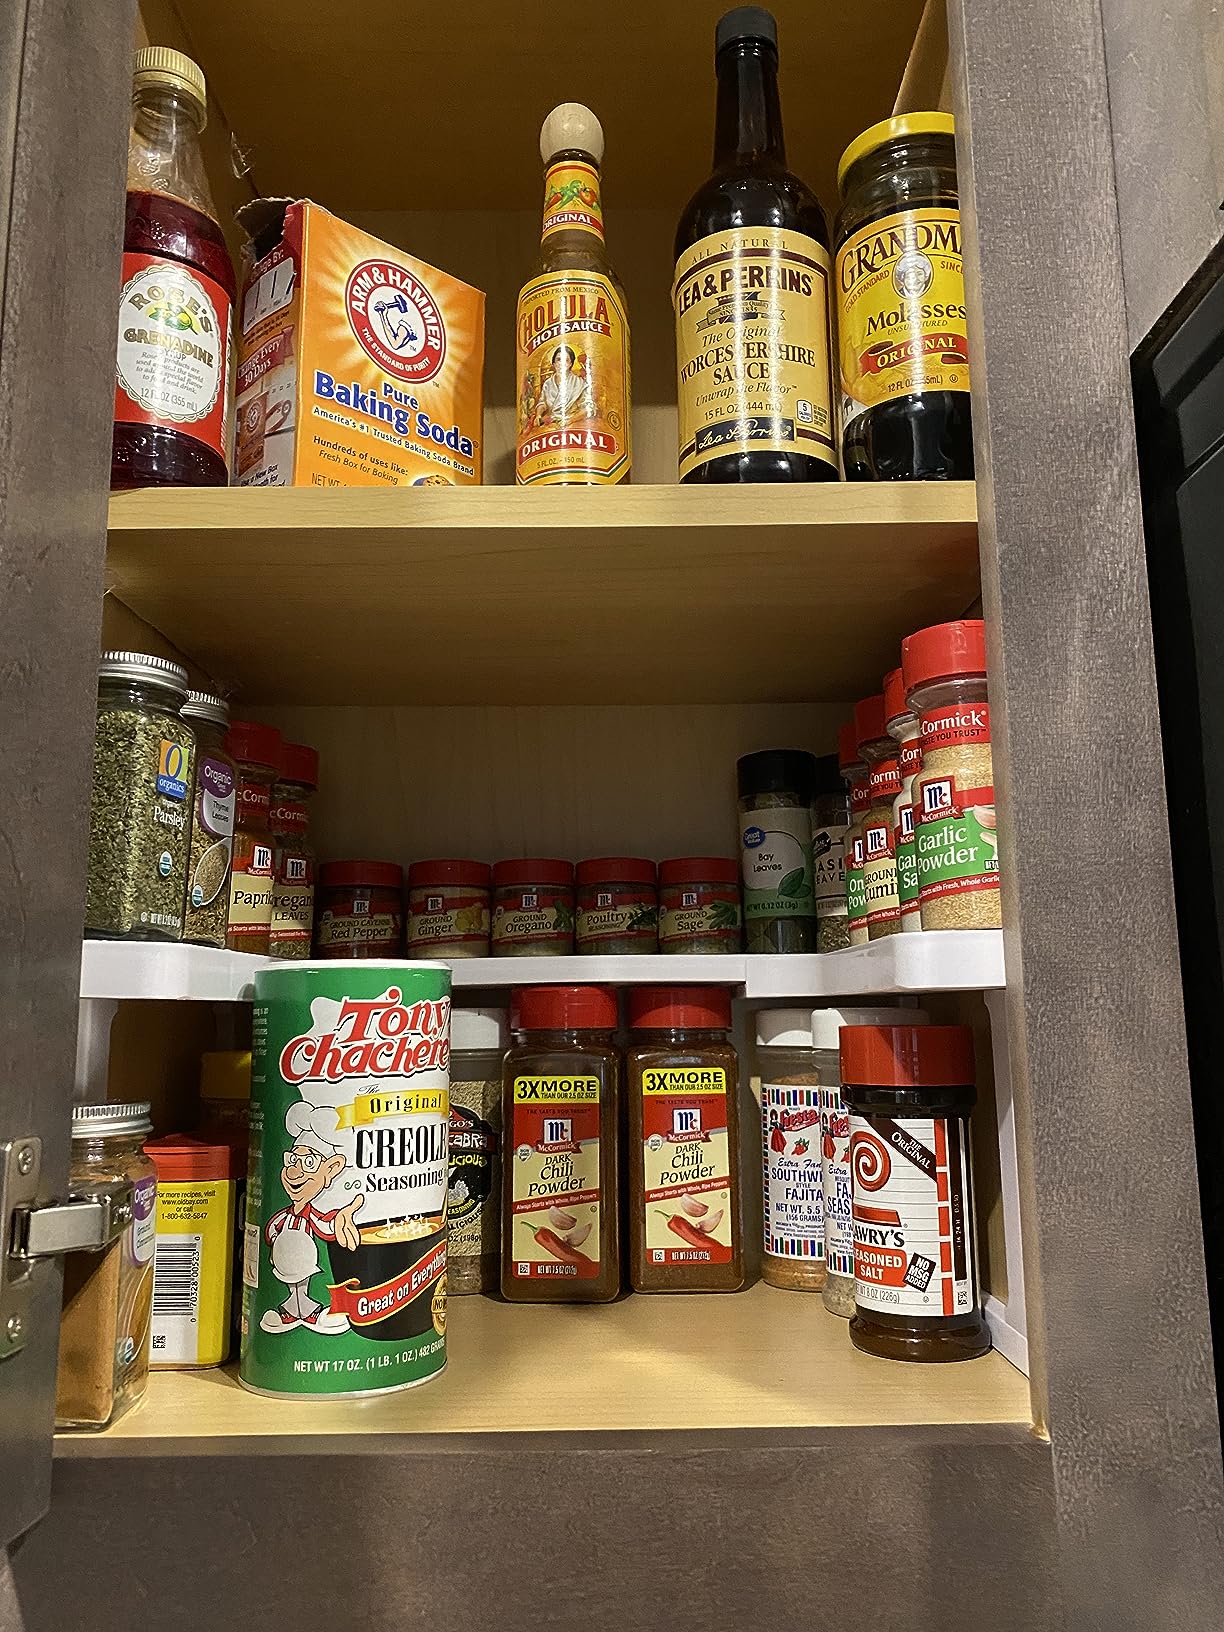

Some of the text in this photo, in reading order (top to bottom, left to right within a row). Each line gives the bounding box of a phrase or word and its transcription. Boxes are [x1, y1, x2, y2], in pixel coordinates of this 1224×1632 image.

[692, 249, 712, 265] ALL
[841, 224, 962, 294] GRANDM
[720, 265, 813, 297] PERRINS
[571, 286, 599, 295] MEXICO
[351, 271, 373, 316] ARM
[388, 268, 441, 351] HAMMER
[866, 302, 967, 337] Molsses
[532, 321, 603, 350] HOT SAUCE
[703, 332, 722, 348] The
[124, 328, 214, 368] GRENADINE
[371, 341, 405, 371] STANDARD
[140, 387, 149, 397] 12
[383, 382, 418, 408] Pure
[695, 386, 735, 407] Unwrap
[315, 371, 473, 454] Baking Soda
[704, 411, 714, 421] 15
[715, 408, 725, 418] FL
[313, 409, 357, 430] America's
[373, 428, 403, 447] Trusted
[404, 441, 431, 460] Baking
[432, 453, 451, 466] Soda
[453, 460, 474, 476] Brand
[522, 431, 609, 459] ORIGINAL
[313, 435, 409, 477] Hundreds of uses like:
[319, 449, 371, 475] Fresh Box for
[921, 711, 986, 736] Cormick
[936, 729, 980, 741] YOU TRUST
[204, 766, 232, 786] Organic
[159, 777, 185, 794] organics
[212, 801, 230, 813] Thyme
[153, 805, 186, 830] Parsley
[918, 825, 968, 853] Garlic
[758, 853, 774, 862] Bay
[916, 843, 979, 875] Powder
[753, 863, 783, 873] Leaves
[960, 877, 981, 887] Whole
[274, 911, 309, 921] LEAVES
[419, 915, 453, 926] GROUND
[512, 912, 548, 923] GROUND
[587, 910, 628, 924] Poultry
[674, 910, 708, 921] GROUND
[330, 919, 359, 929] GROUND
[417, 924, 454, 937] Ginger
[505, 920, 552, 934] Oregano
[676, 919, 704, 932] Sage
[331, 927, 388, 941] Red Pepper
[338, 988, 449, 1045] Tony
[646, 1071, 723, 1091] 3X MORE
[670, 1083, 685, 1091] THAN
[517, 1080, 597, 1099] 3X MORE
[370, 1093, 442, 1114] Original
[668, 1132, 706, 1142] McCormick
[909, 1138, 922, 1151] THE
[537, 1142, 577, 1152] McCormick
[675, 1142, 701, 1154] DARK
[891, 1131, 931, 1170] ORIGINAL
[545, 1153, 572, 1166] DARK
[671, 1150, 704, 1169] Chili
[777, 1158, 800, 1168] Extra
[540, 1161, 574, 1181] Chili
[659, 1164, 716, 1185] Powder
[829, 1164, 848, 1176] Extra
[366, 1168, 443, 1194] Seasoning
[528, 1176, 586, 1198] Powder
[180, 1190, 203, 1200] recipes,
[203, 1189, 216, 1198] visit
[785, 1187, 823, 1201] FAJITA
[775, 1202, 821, 1214] NET WT. 5.5
[915, 1257, 930, 1271] NO
[189, 1251, 201, 1308] 70328 00523
[860, 1265, 884, 1281] SALT
[909, 1265, 930, 1281] MSG
[905, 1275, 927, 1289] ADDED
[357, 1283, 409, 1317] Great on
[293, 1360, 312, 1373] NET
[313, 1360, 330, 1372] WT
[332, 1359, 344, 1371] 17
[346, 1359, 364, 1371] OZ.
[366, 1357, 376, 1372] (1
[378, 1356, 393, 1368] LB.
[402, 1349, 419, 1363] OZ.)
[418, 1346, 431, 1358] 482
